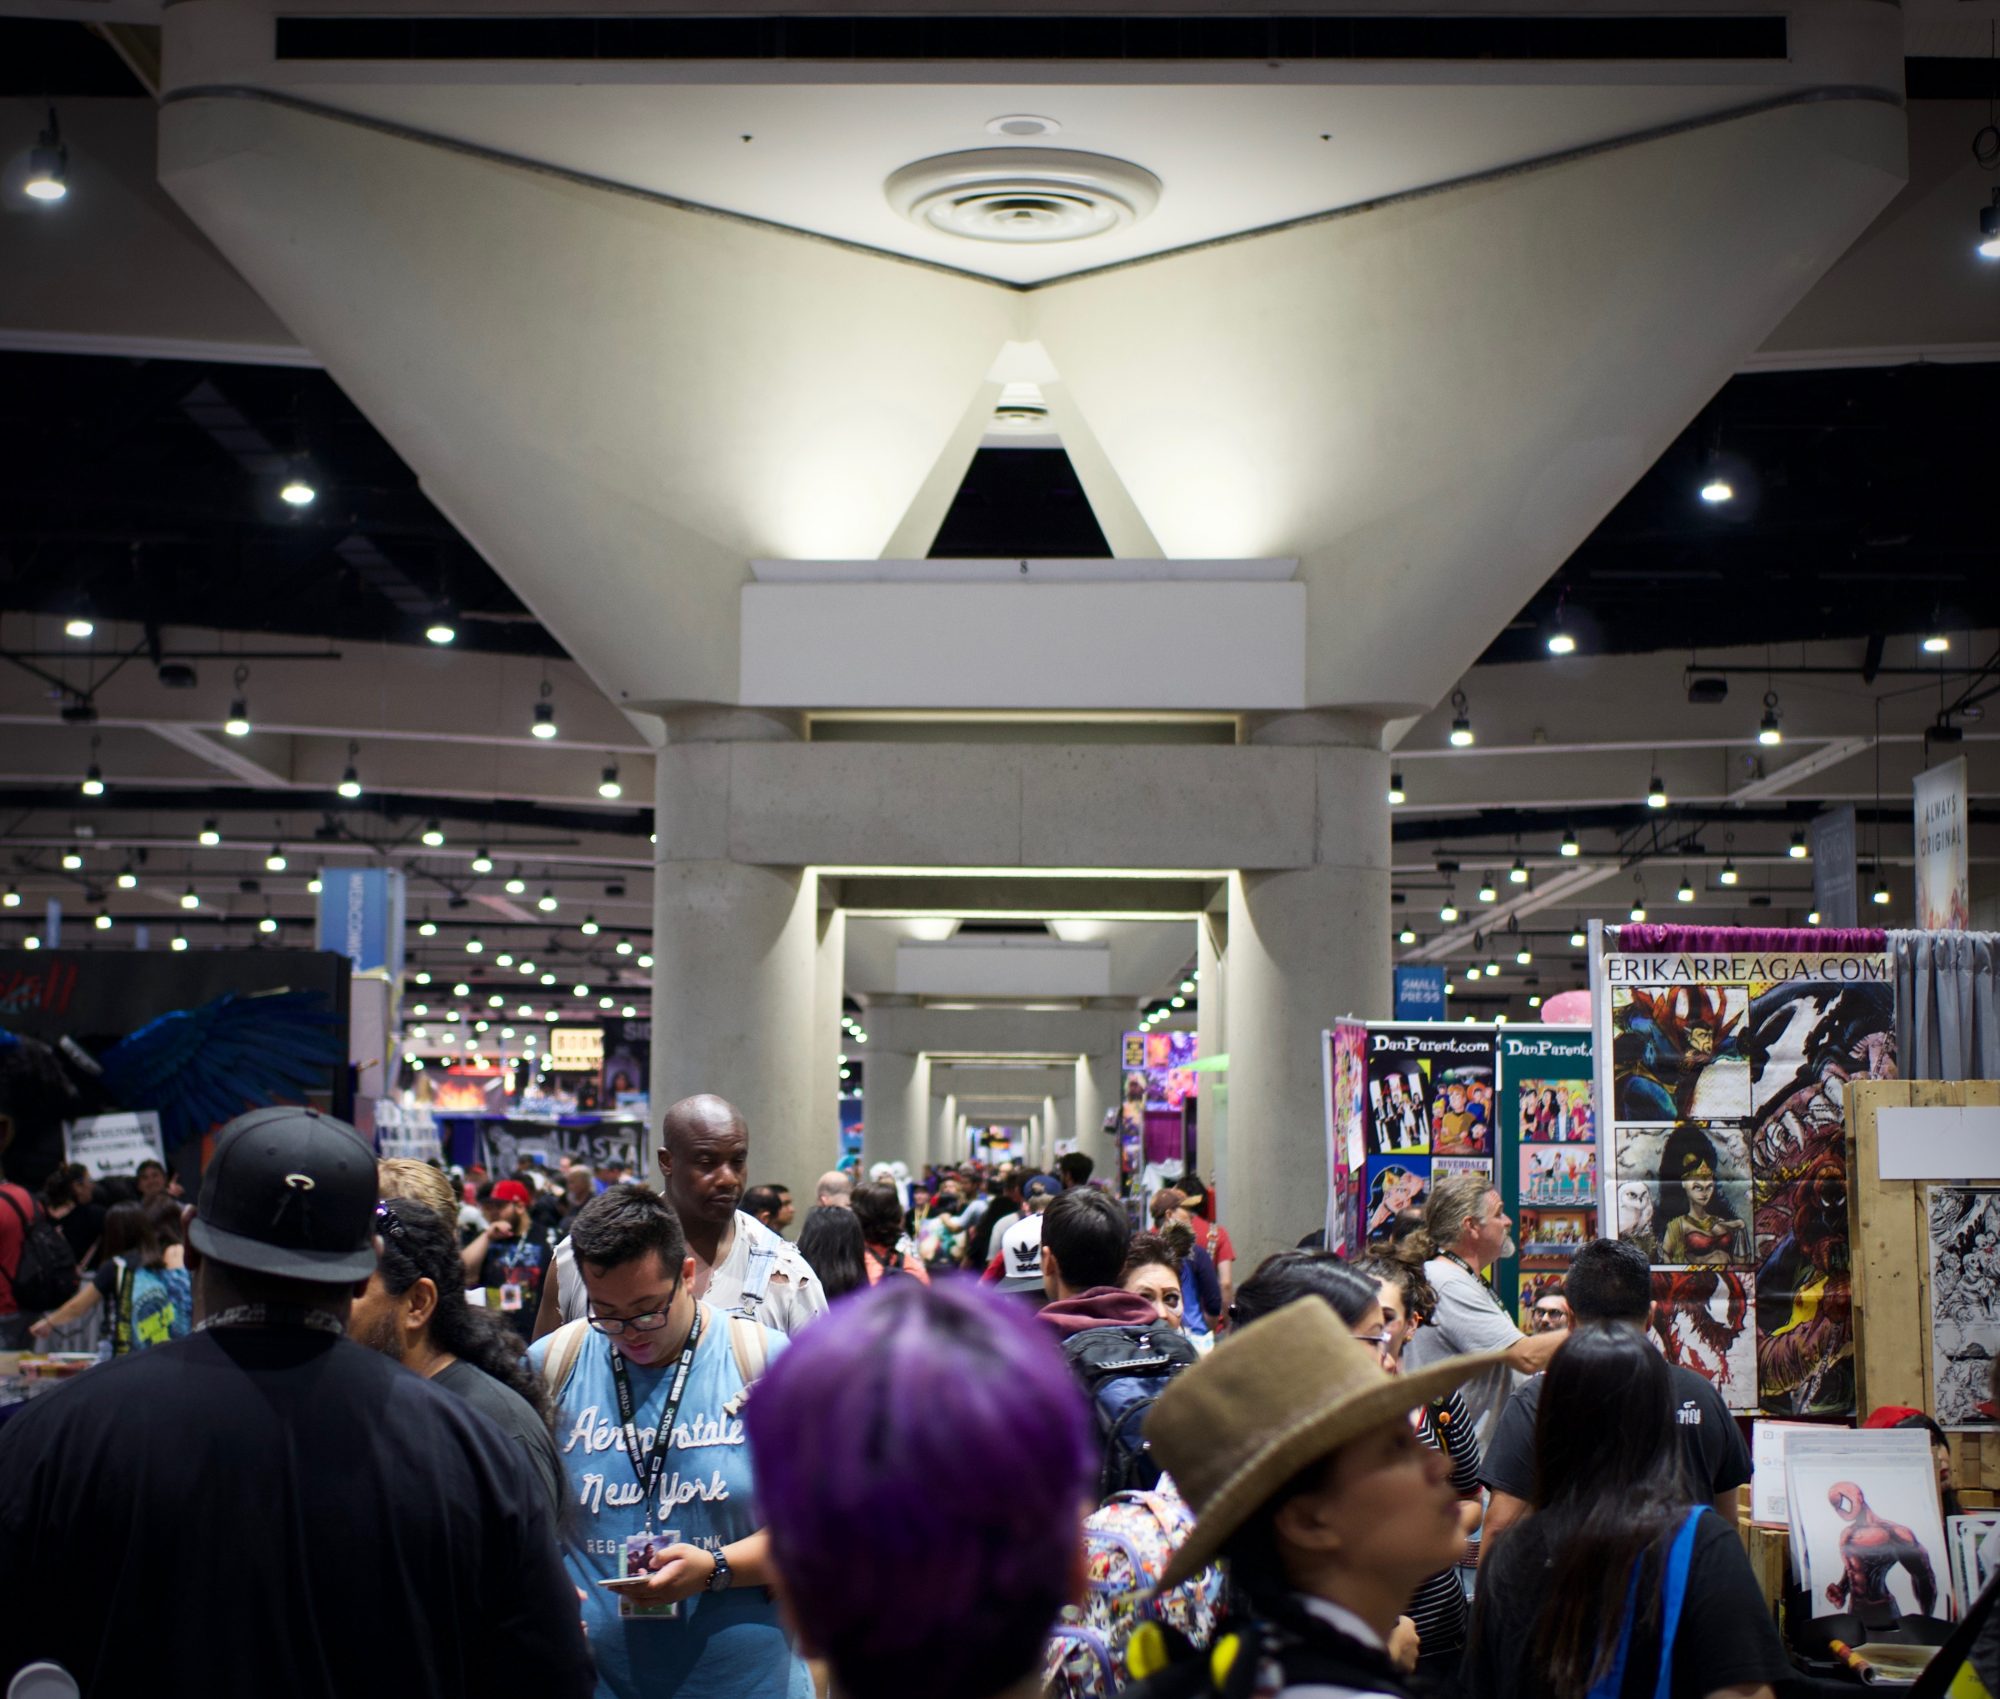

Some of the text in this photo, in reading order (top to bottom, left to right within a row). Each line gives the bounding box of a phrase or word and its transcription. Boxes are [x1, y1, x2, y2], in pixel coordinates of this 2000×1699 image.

[1925, 794, 1957, 822] ALWAYS
[1920, 824, 1962, 857] ORIGINAL
[1607, 958, 1887, 981] ERIKARREAGA.COM
[1401, 979, 1440, 991] SMALL
[1400, 991, 1441, 1004] PRESS
[1373, 1034, 1490, 1053] DanParent.com
[1437, 1159, 1489, 1170] RIVERDALE
[579, 1472, 646, 1515] New
[657, 1470, 730, 1521] York
